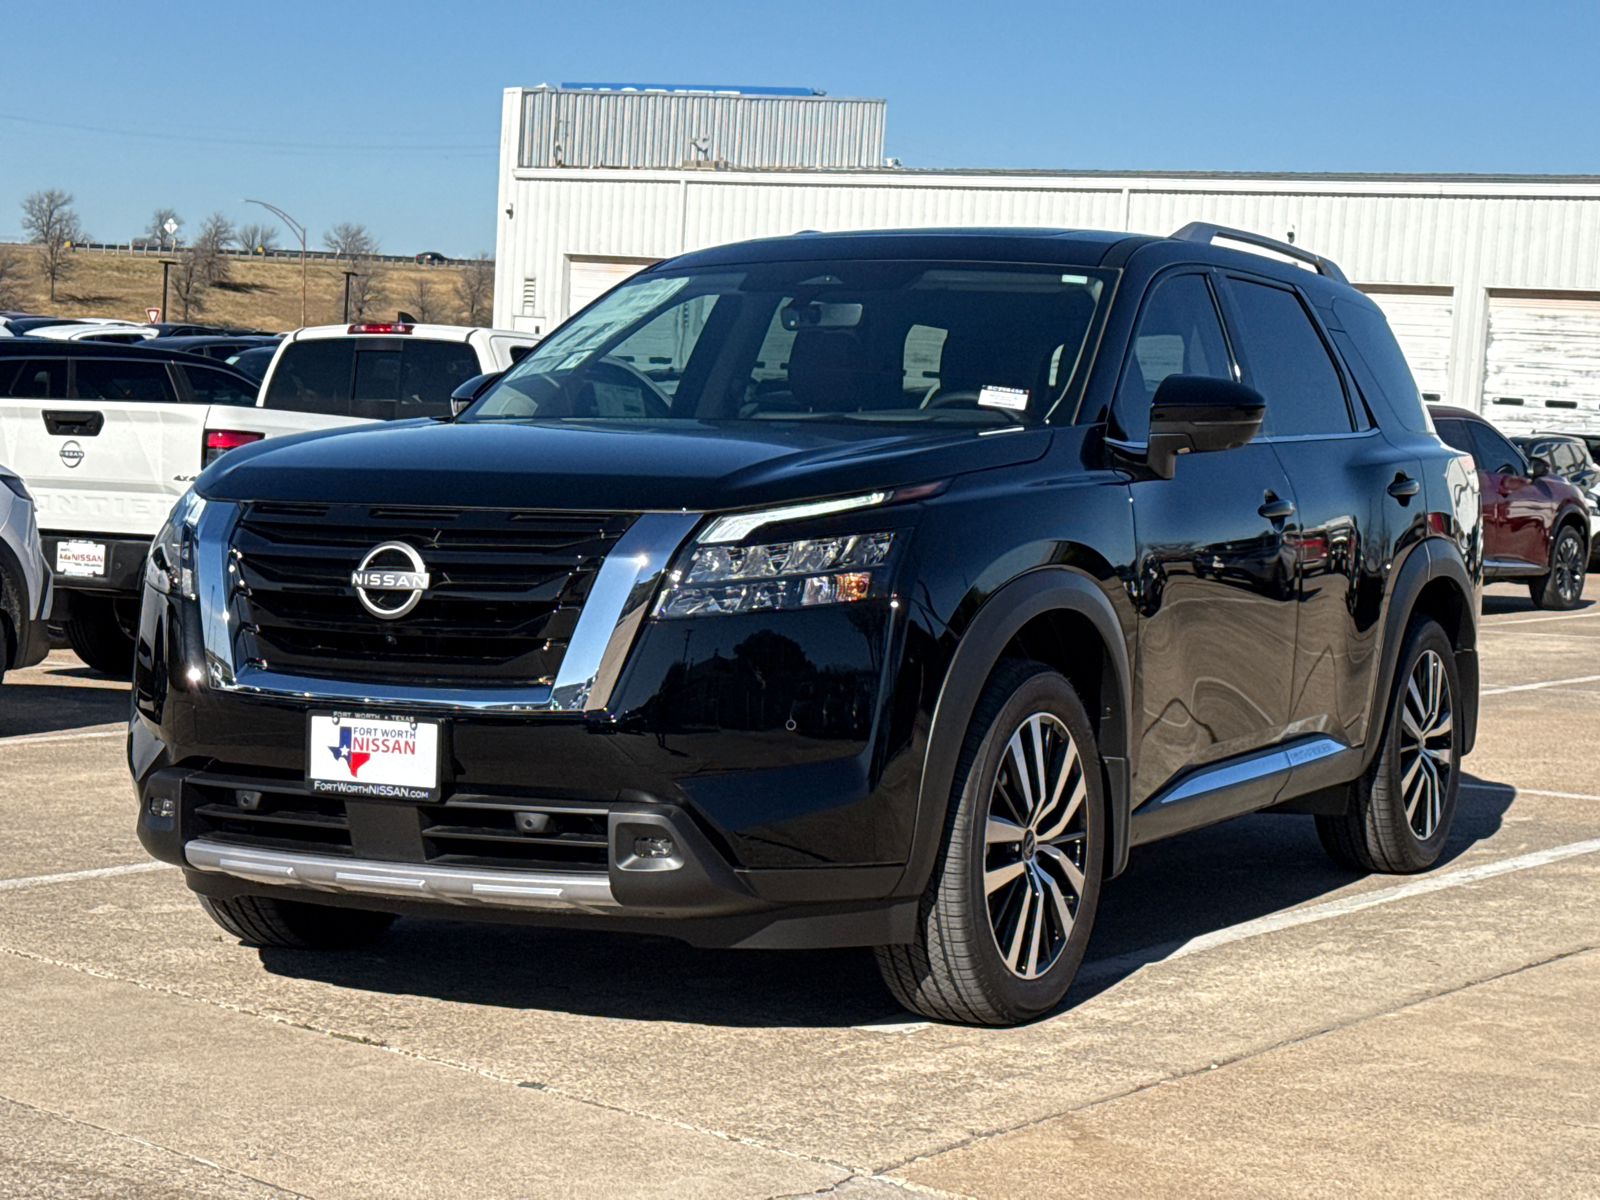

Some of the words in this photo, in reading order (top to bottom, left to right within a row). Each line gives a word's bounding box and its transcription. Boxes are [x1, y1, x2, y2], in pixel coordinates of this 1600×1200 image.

[72, 553, 103, 563] NISSAN
[352, 573, 426, 587] NISSAN
[354, 712, 380, 720] WORTH
[353, 726, 378, 737] FORT
[381, 729, 416, 739] WORTH
[353, 737, 416, 755] NISSAN
